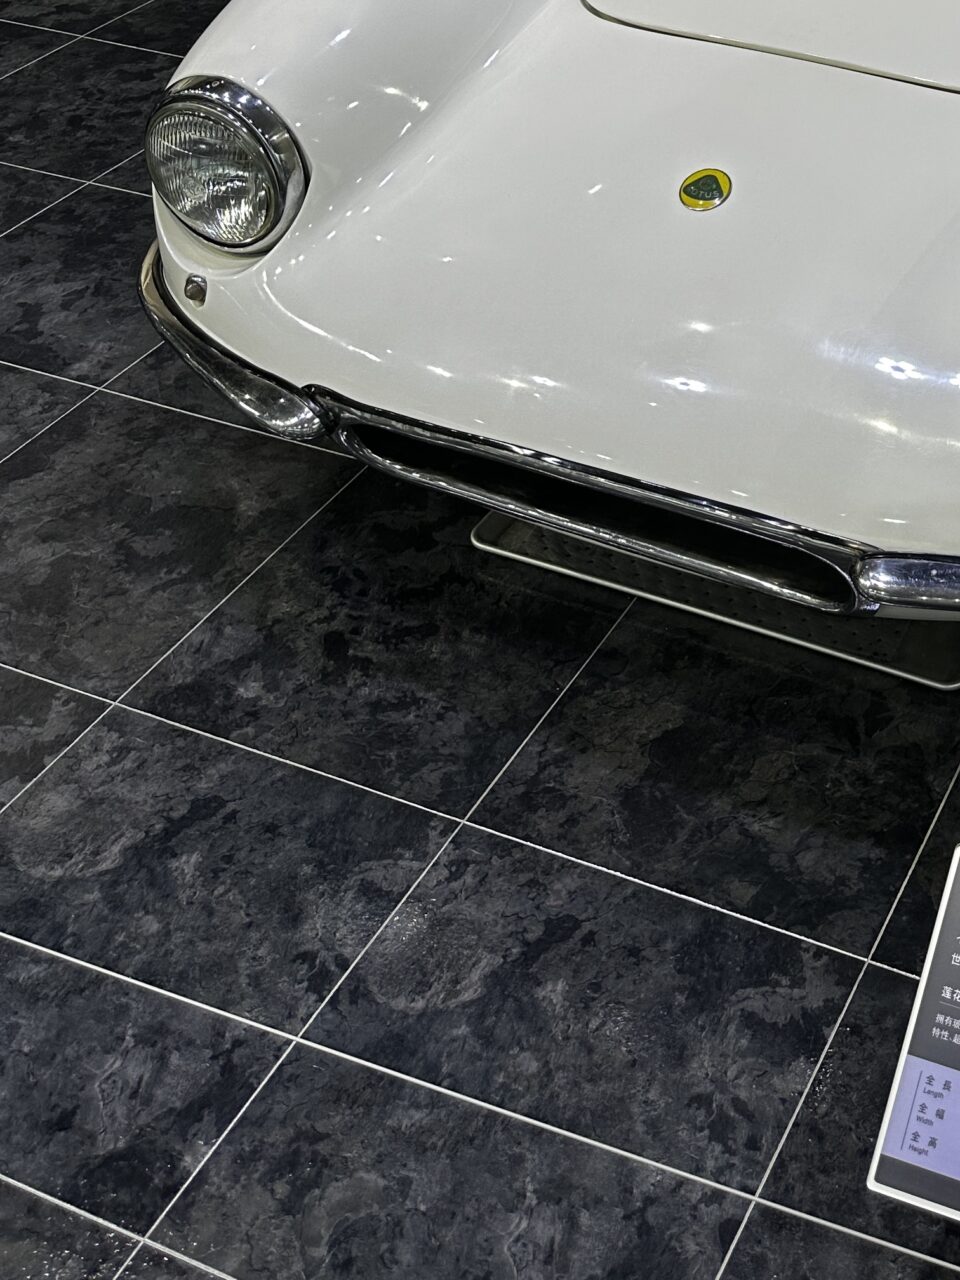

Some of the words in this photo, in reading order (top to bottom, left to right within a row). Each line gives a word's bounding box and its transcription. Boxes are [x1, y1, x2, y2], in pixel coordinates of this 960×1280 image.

[687, 186, 720, 199] LOTUS
[922, 1087, 945, 1099] Length
[916, 1114, 934, 1127] Width
[908, 1143, 929, 1157] Height
